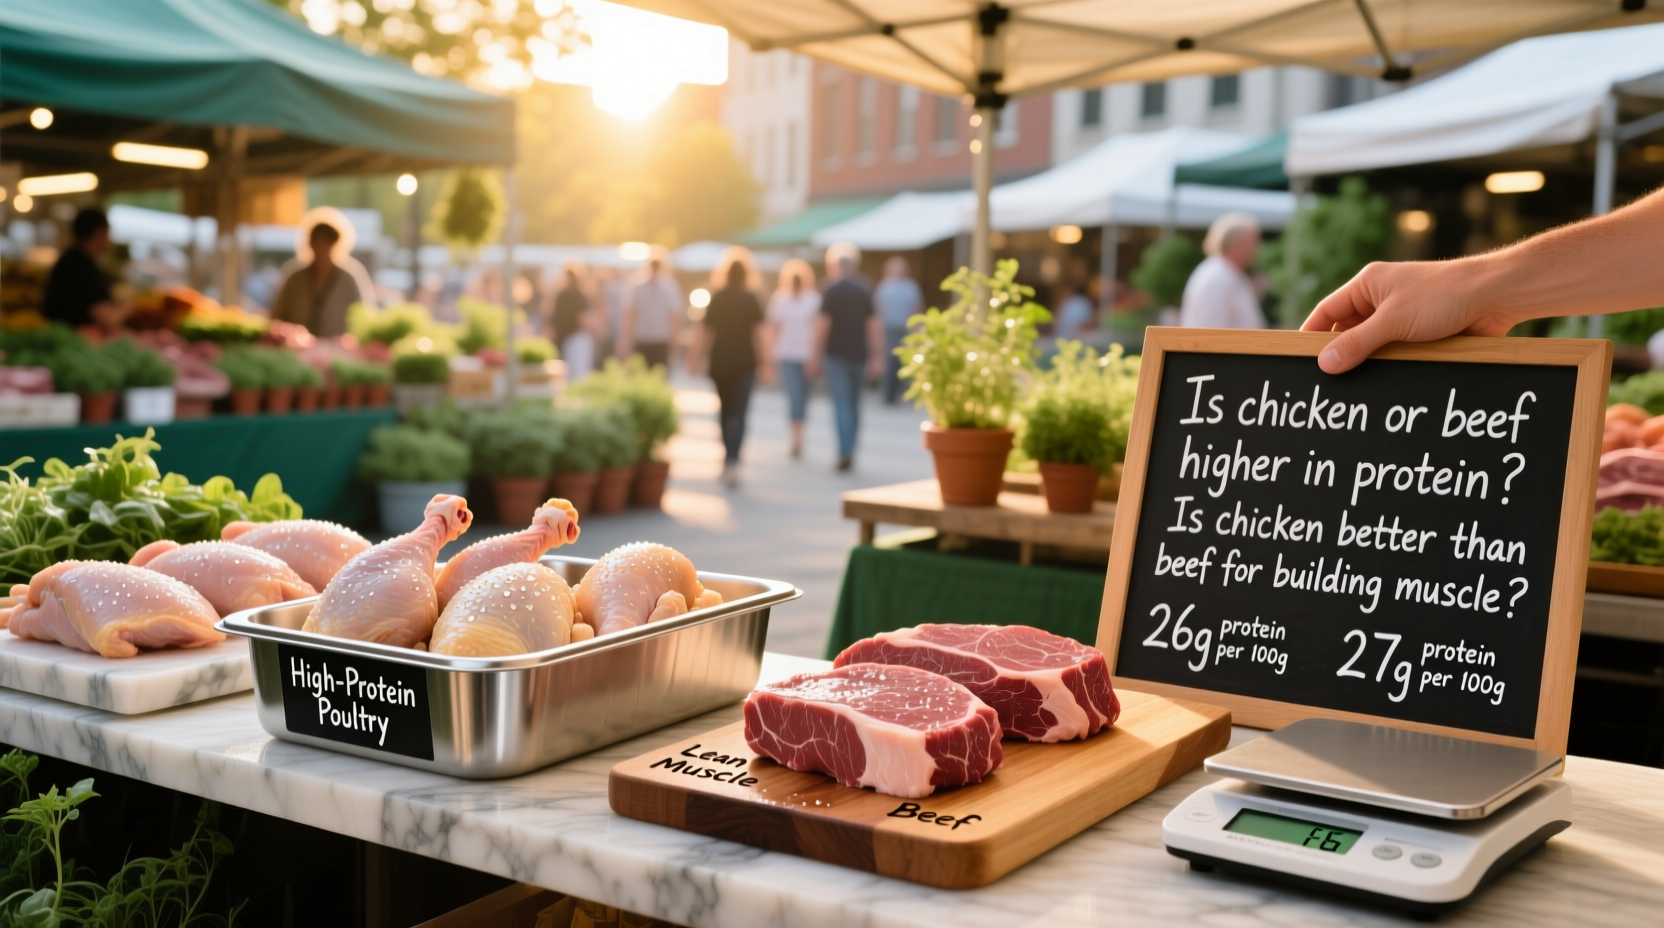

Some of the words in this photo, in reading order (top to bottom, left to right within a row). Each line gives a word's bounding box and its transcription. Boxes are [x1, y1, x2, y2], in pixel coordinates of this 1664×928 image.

[1179, 374, 1225, 425] Is
[1237, 379, 1368, 432] chicken
[1384, 404, 1429, 434] or
[1441, 387, 1537, 444] beef
[1179, 434, 1292, 498] higher
[1303, 449, 1336, 488] in
[1166, 495, 1204, 534] Is
[1215, 500, 1324, 544] chicken
[1336, 509, 1438, 554] better
[1449, 520, 1526, 565] than
[1154, 541, 1218, 585] beef
[1220, 548, 1264, 587] for
[1272, 552, 1383, 614] building
[1394, 573, 1529, 619] muscle?
[1142, 602, 1213, 673] 26g
[1219, 615, 1286, 642] protein
[1420, 639, 1496, 668] protein
[290, 656, 416, 708] High-Protein
[1214, 643, 1245, 666] per
[1250, 643, 1289, 675] 100g
[1335, 629, 1413, 703] 27g
[1419, 670, 1453, 693] per
[1460, 671, 1506, 706] 100g
[318, 696, 389, 747] Poultry
[650, 757, 759, 787] Muscle
[680, 744, 747, 768] Lean
[886, 802, 982, 830] Beef
